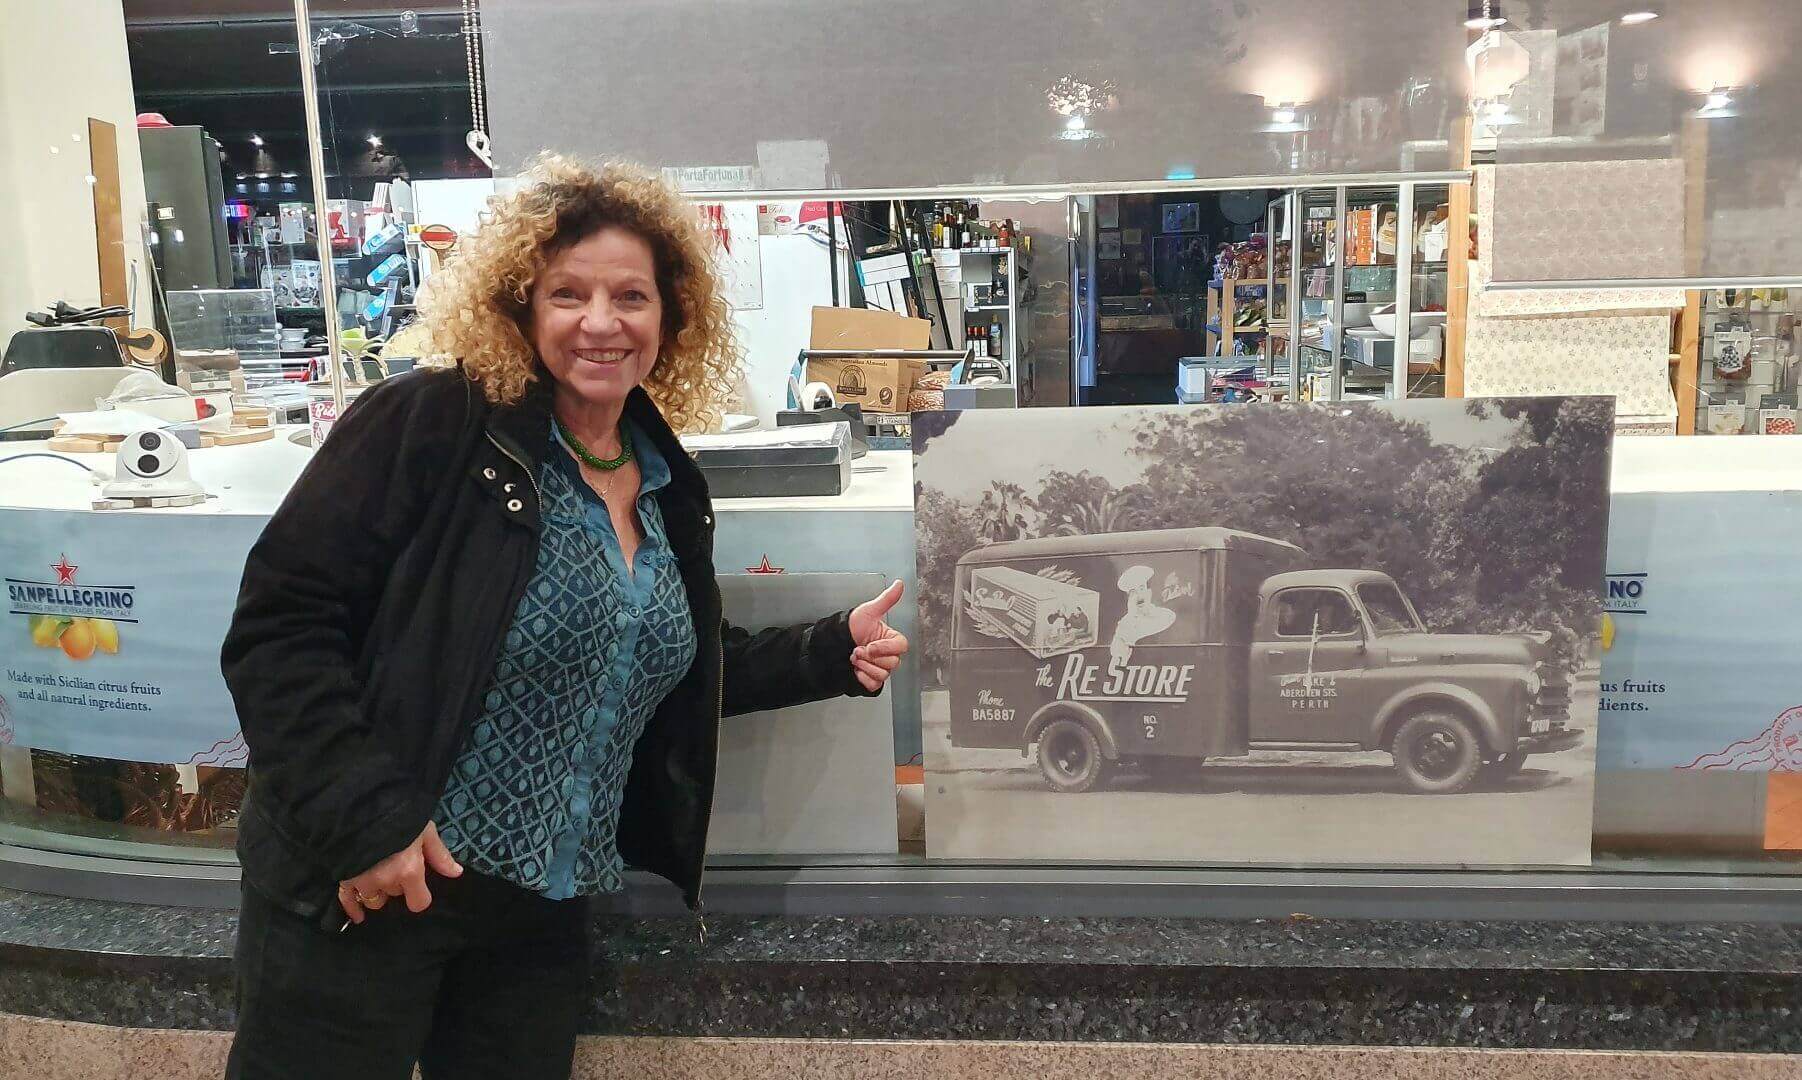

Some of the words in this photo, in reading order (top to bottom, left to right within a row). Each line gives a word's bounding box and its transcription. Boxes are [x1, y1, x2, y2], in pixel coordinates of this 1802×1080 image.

[9, 585, 133, 608] SANPELLEGRINO
[7, 669, 32, 683] Made
[35, 674, 56, 686] with
[59, 676, 95, 690] Sicilian
[98, 680, 128, 693] citrus
[131, 682, 161, 696] fruits
[1036, 663, 1054, 688] The
[1280, 689, 1321, 698] ABERDEN
[1623, 679, 1666, 693] fruits
[18, 688, 35, 700] and
[37, 690, 48, 701] all
[51, 693, 86, 706] natural
[89, 696, 152, 712] ingredients.
[978, 689, 1004, 707] Phone
[1292, 700, 1329, 709] PERTH
[972, 709, 1016, 721] BA5887
[1146, 726, 1155, 738] 2
